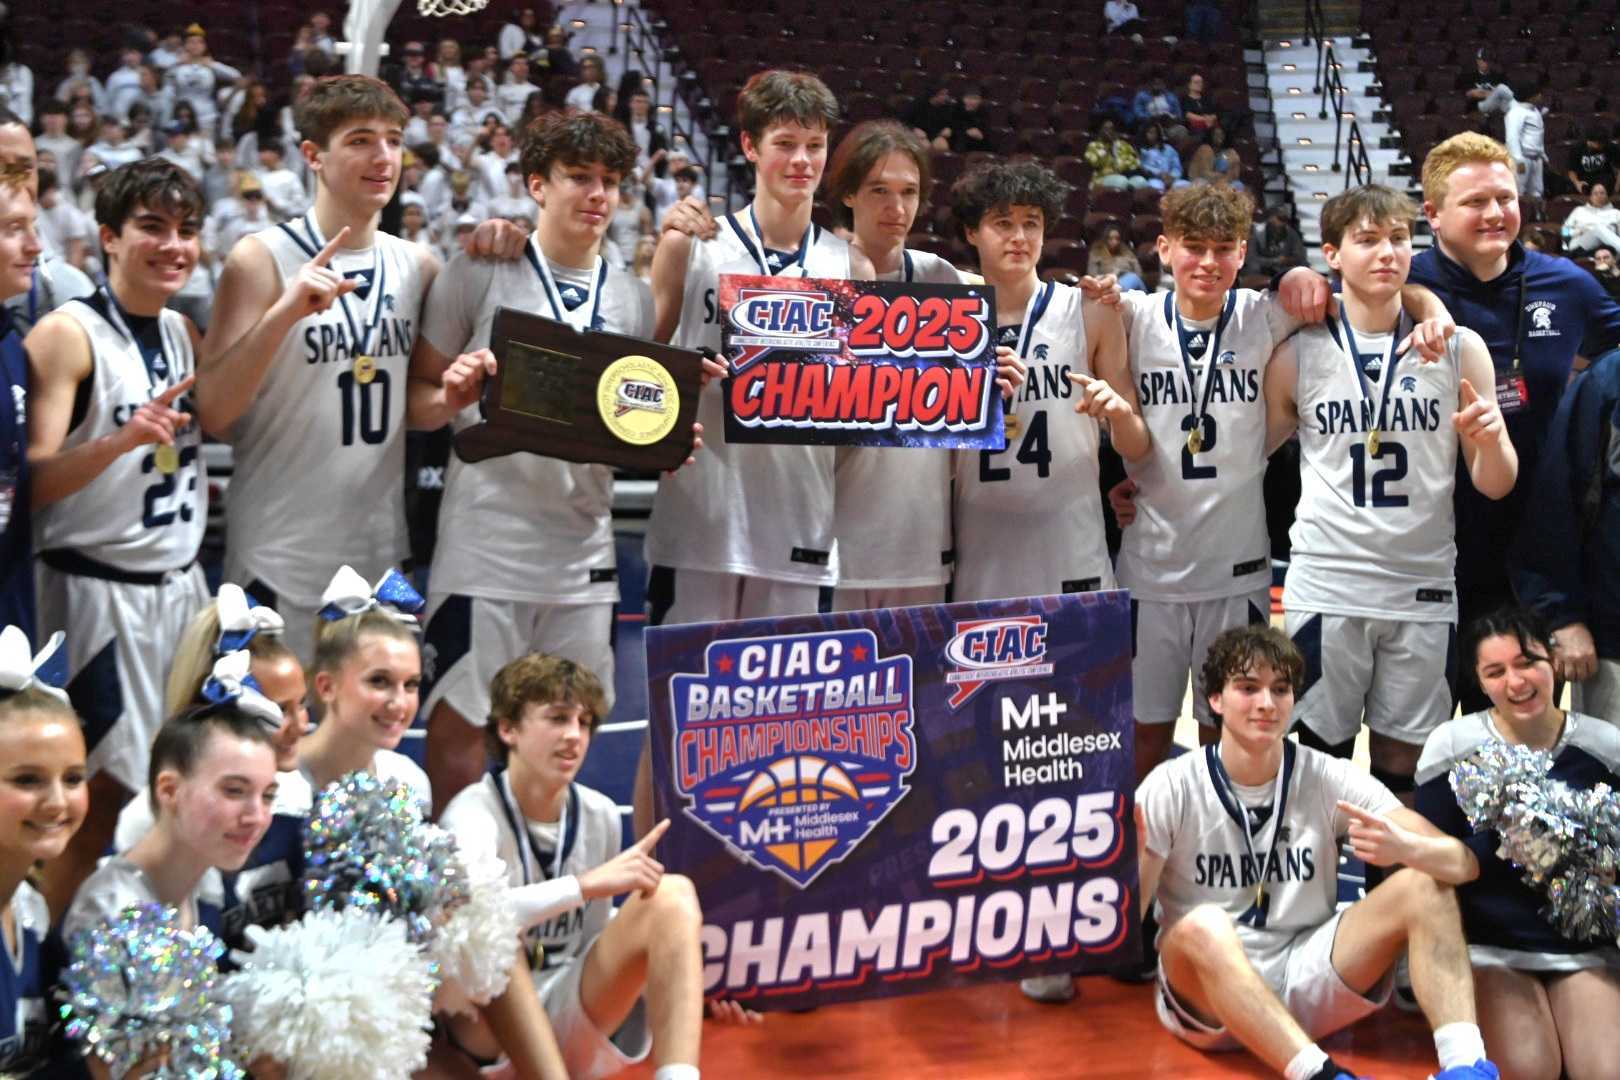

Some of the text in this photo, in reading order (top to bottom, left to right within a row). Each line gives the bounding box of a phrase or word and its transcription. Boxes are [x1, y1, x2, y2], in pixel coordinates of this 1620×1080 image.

[746, 300, 833, 333] CIAC
[849, 294, 987, 355] 2025
[304, 318, 411, 364] SPAANS
[338, 369, 391, 446] 10
[623, 383, 665, 403] CIAC
[730, 361, 987, 428] CHAMPION
[1140, 368, 1259, 406] SPARANS
[1181, 412, 1217, 480] 2
[1349, 441, 1409, 508] 12
[738, 638, 843, 681] CIAC
[962, 622, 1049, 664] CIAC
[686, 666, 904, 723] BASKETBALL
[679, 710, 911, 791] CHAMPIONSHIPS
[1002, 731, 1122, 762] Middlesex
[1004, 757, 1083, 787] Health
[767, 802, 832, 817] PRESENTED BY
[794, 811, 860, 827] Middlesex
[794, 824, 839, 839] Health
[928, 790, 1114, 881] 2025
[1195, 847, 1315, 888] SPARTANS
[700, 876, 1122, 996] CHAMPIONS
